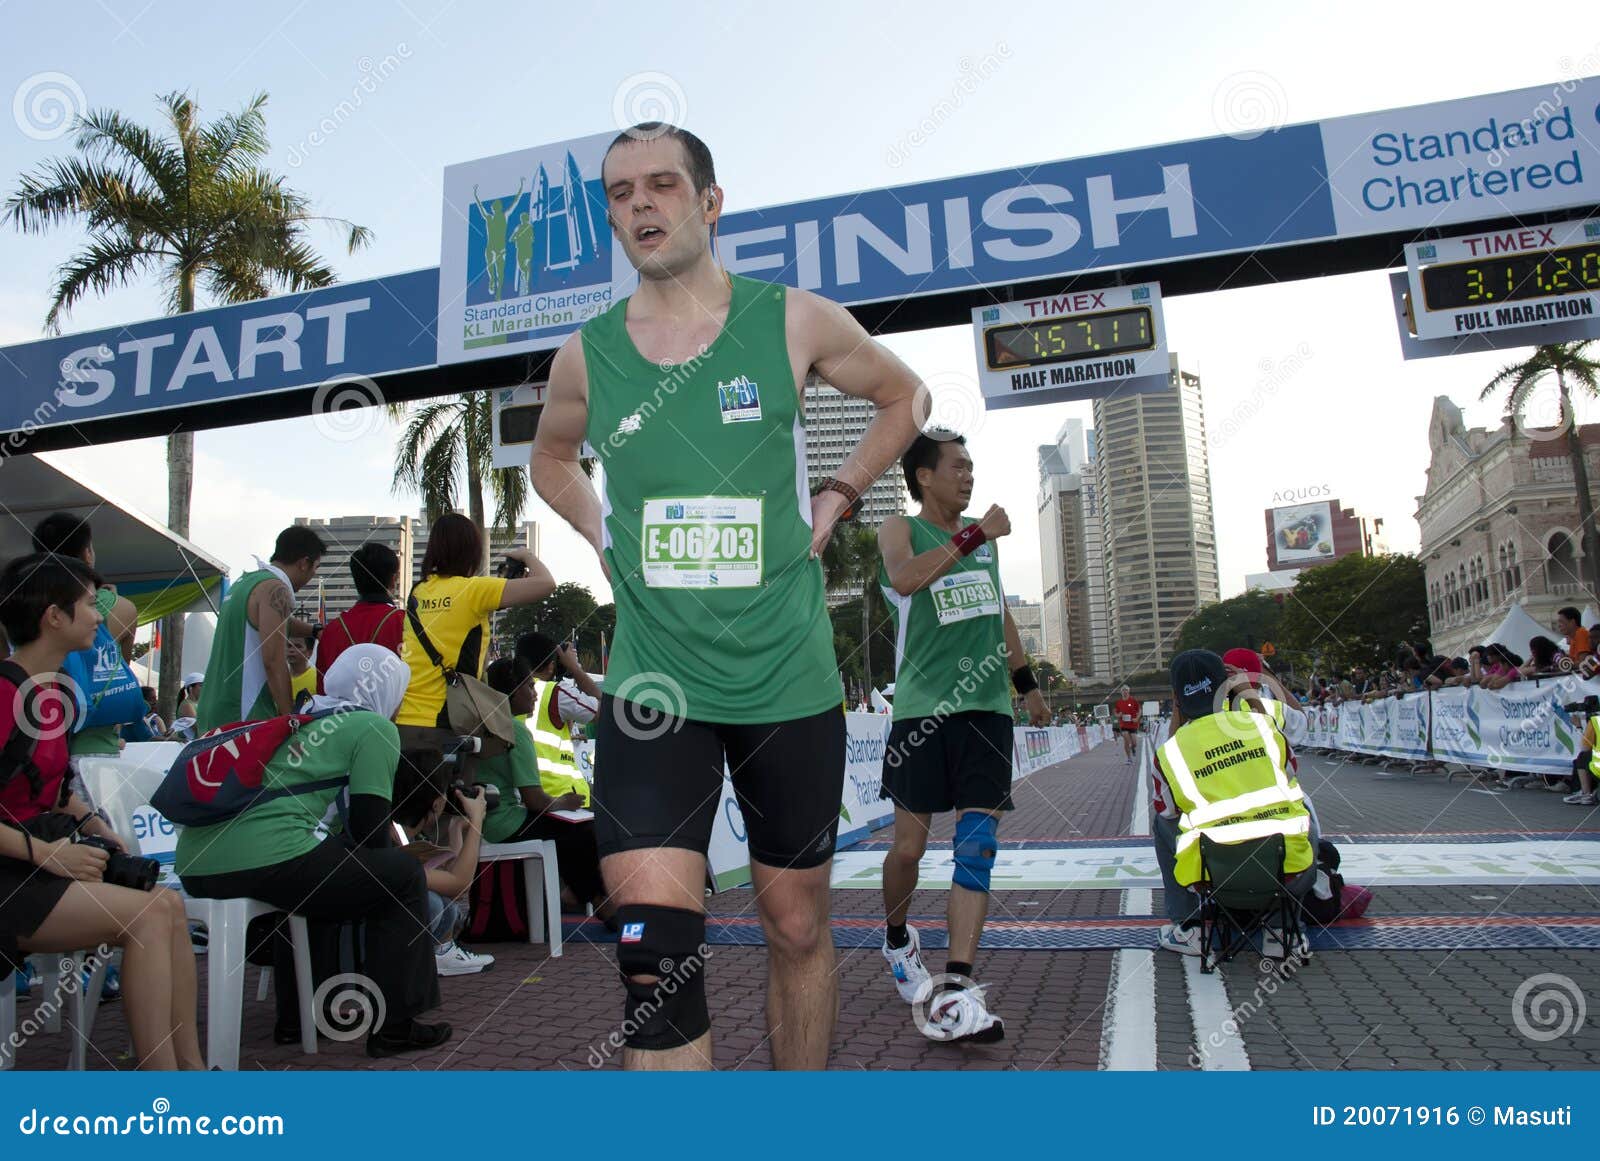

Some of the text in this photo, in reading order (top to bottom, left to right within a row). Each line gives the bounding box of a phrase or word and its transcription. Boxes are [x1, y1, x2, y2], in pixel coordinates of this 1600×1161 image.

[1371, 106, 1575, 167] Standard
[1362, 151, 1583, 212] Chartered
[713, 163, 1198, 291] FINISH
[1462, 227, 1556, 256] TIMEX
[464, 287, 612, 323] Standard Chartered
[1024, 292, 1107, 318] TIMEX
[1455, 297, 1593, 332] FULL MARATHON
[464, 323, 485, 339] KL
[492, 310, 573, 334] Marathon
[1034, 316, 1145, 358] 1.57.11
[58, 298, 371, 408] START
[1011, 358, 1137, 391] HALF MARATHON
[1272, 484, 1331, 503] AQUOS
[648, 527, 754, 560] E-06203
[421, 596, 451, 610] MSIG
[937, 584, 994, 609] E-07933
[1193, 747, 1267, 780] PHOTOGRAPHER
[1204, 739, 1246, 760] OFFICIAL
[623, 924, 642, 937] LP
